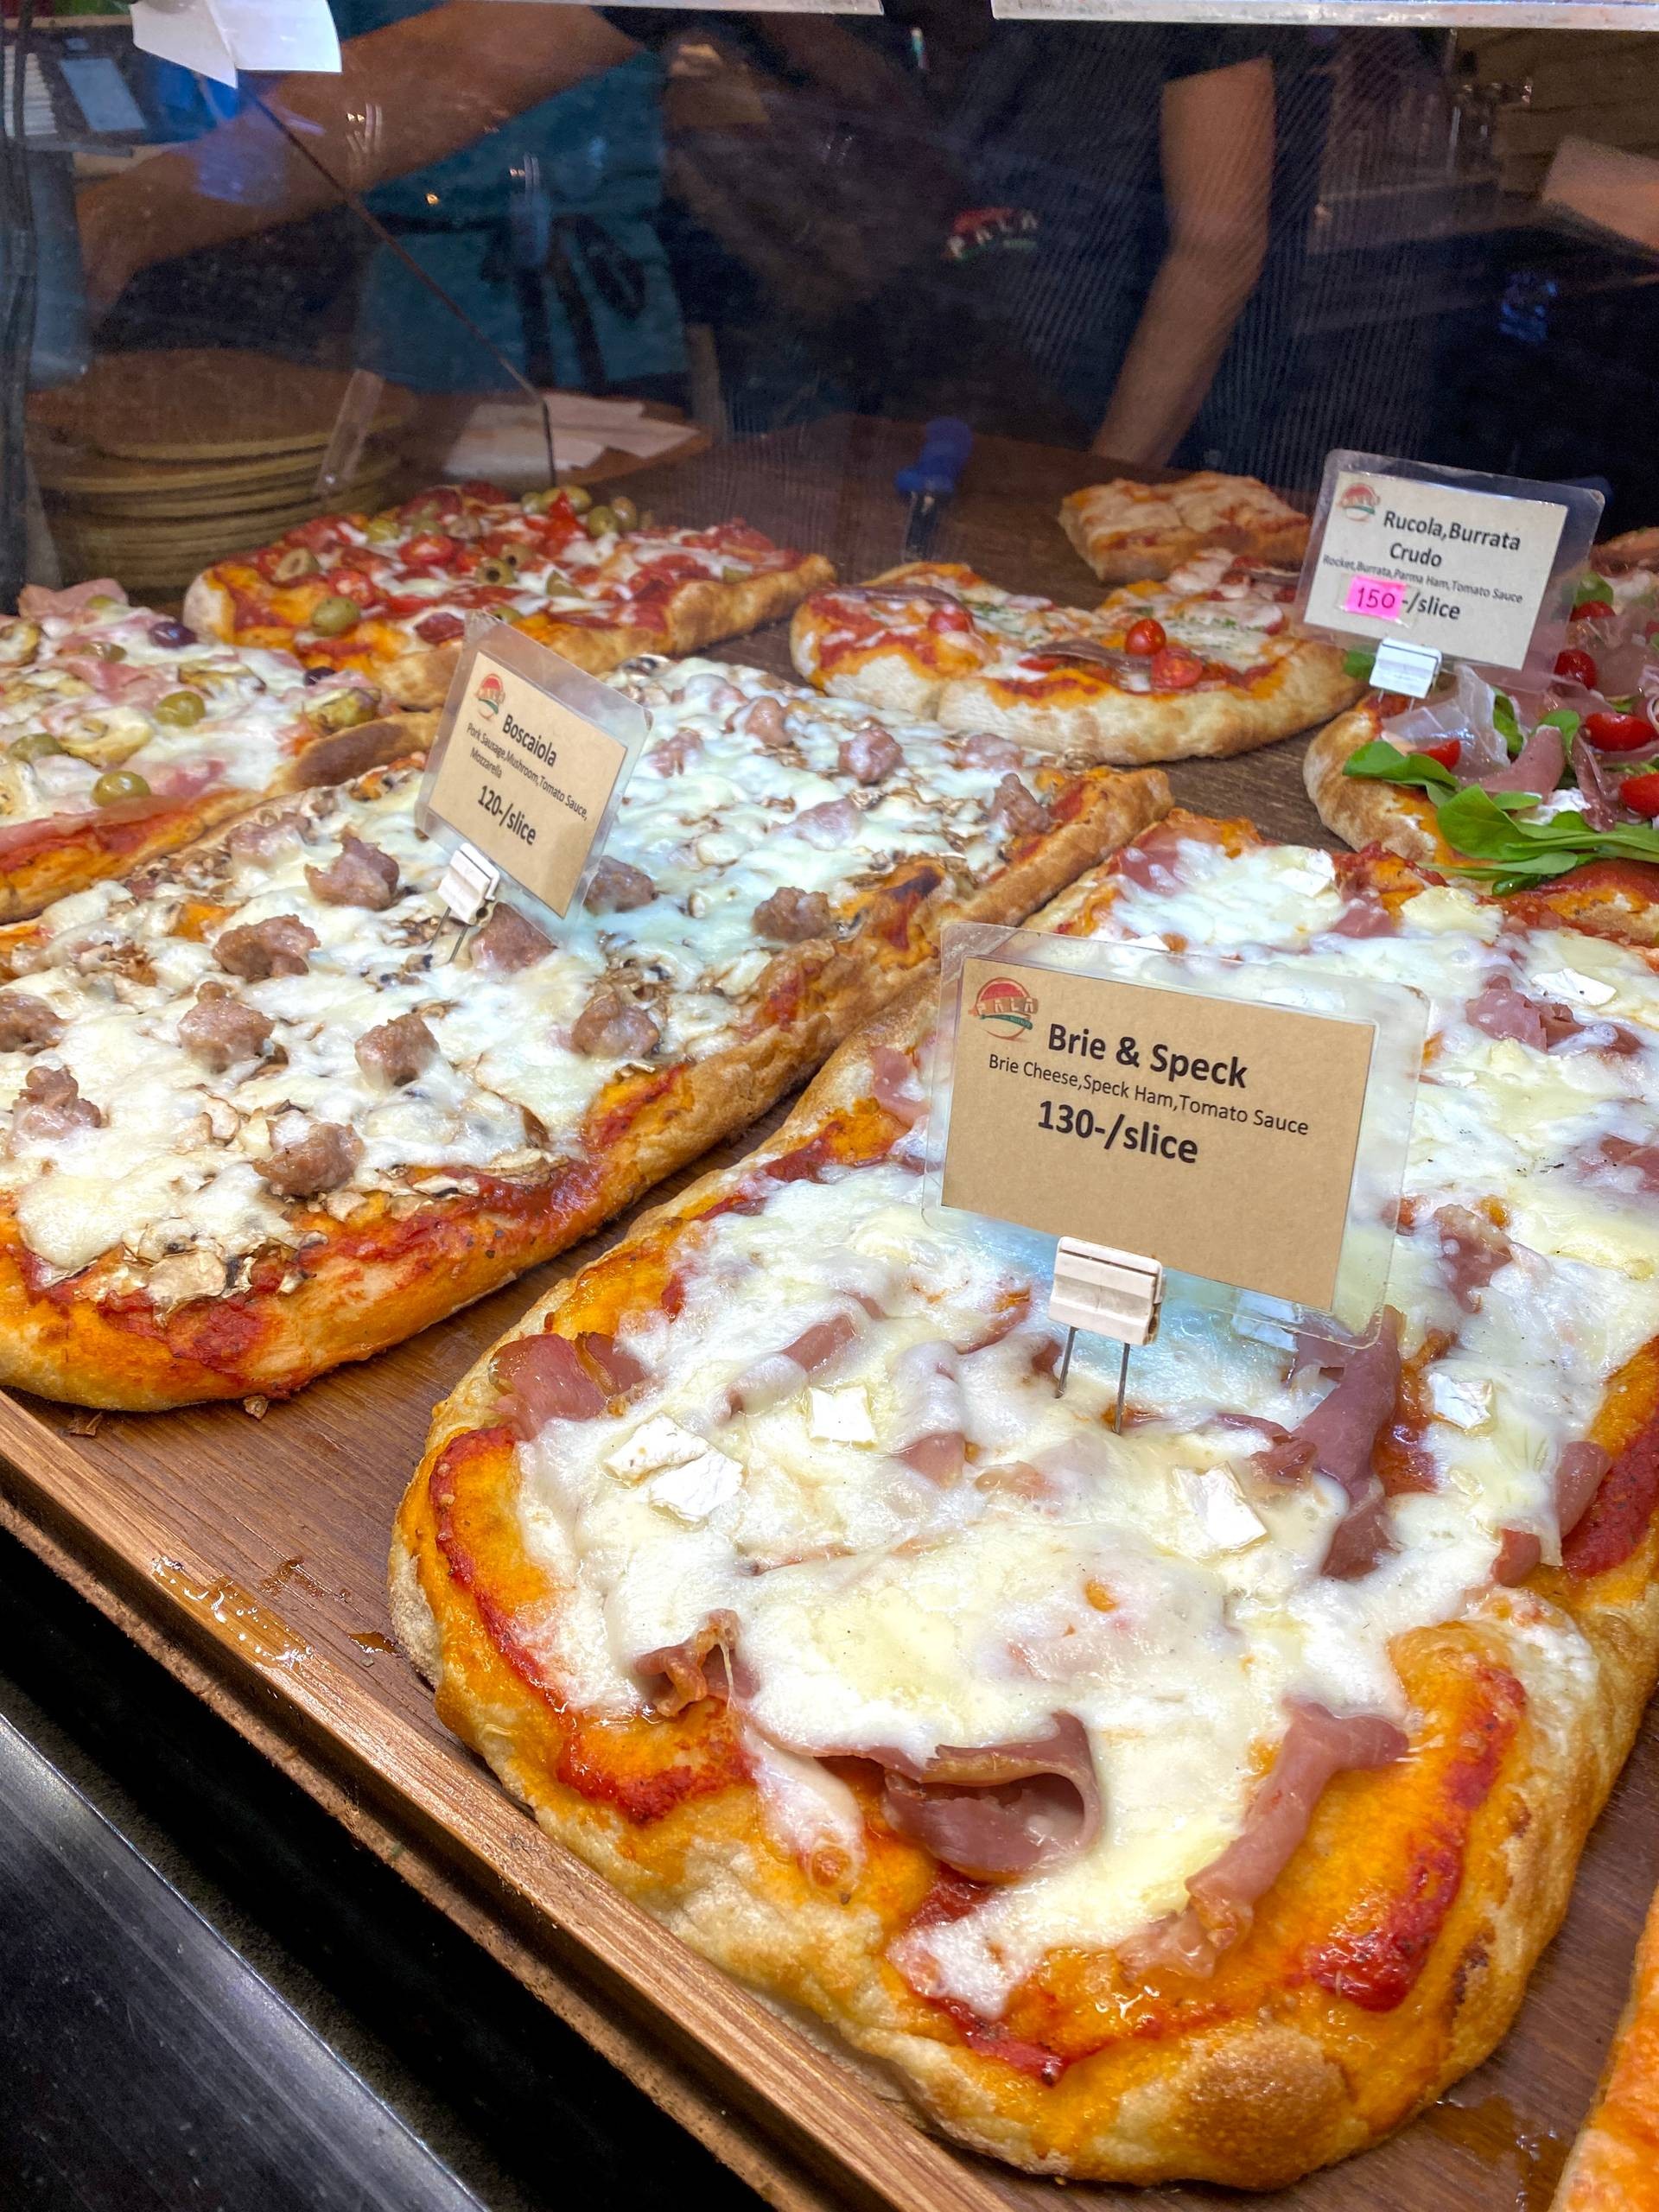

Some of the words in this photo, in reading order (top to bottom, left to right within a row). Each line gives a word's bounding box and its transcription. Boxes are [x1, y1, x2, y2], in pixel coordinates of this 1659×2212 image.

[1389, 543, 1442, 568] Crudo
[1493, 589, 1522, 603] Sauce
[470, 747, 503, 779] Mozzarella
[503, 715, 556, 766] Boscaiola
[467, 722, 480, 741] Pork
[565, 795, 588, 821] Sauce,
[478, 785, 536, 845] 120-/slice
[1049, 1023, 1105, 1059] Brie
[1116, 1036, 1140, 1067] &
[1150, 1044, 1248, 1088] Speck
[989, 1054, 1019, 1073] Brie
[1253, 1109, 1309, 1135] Sauce
[1039, 1101, 1198, 1163] 130-/slice
